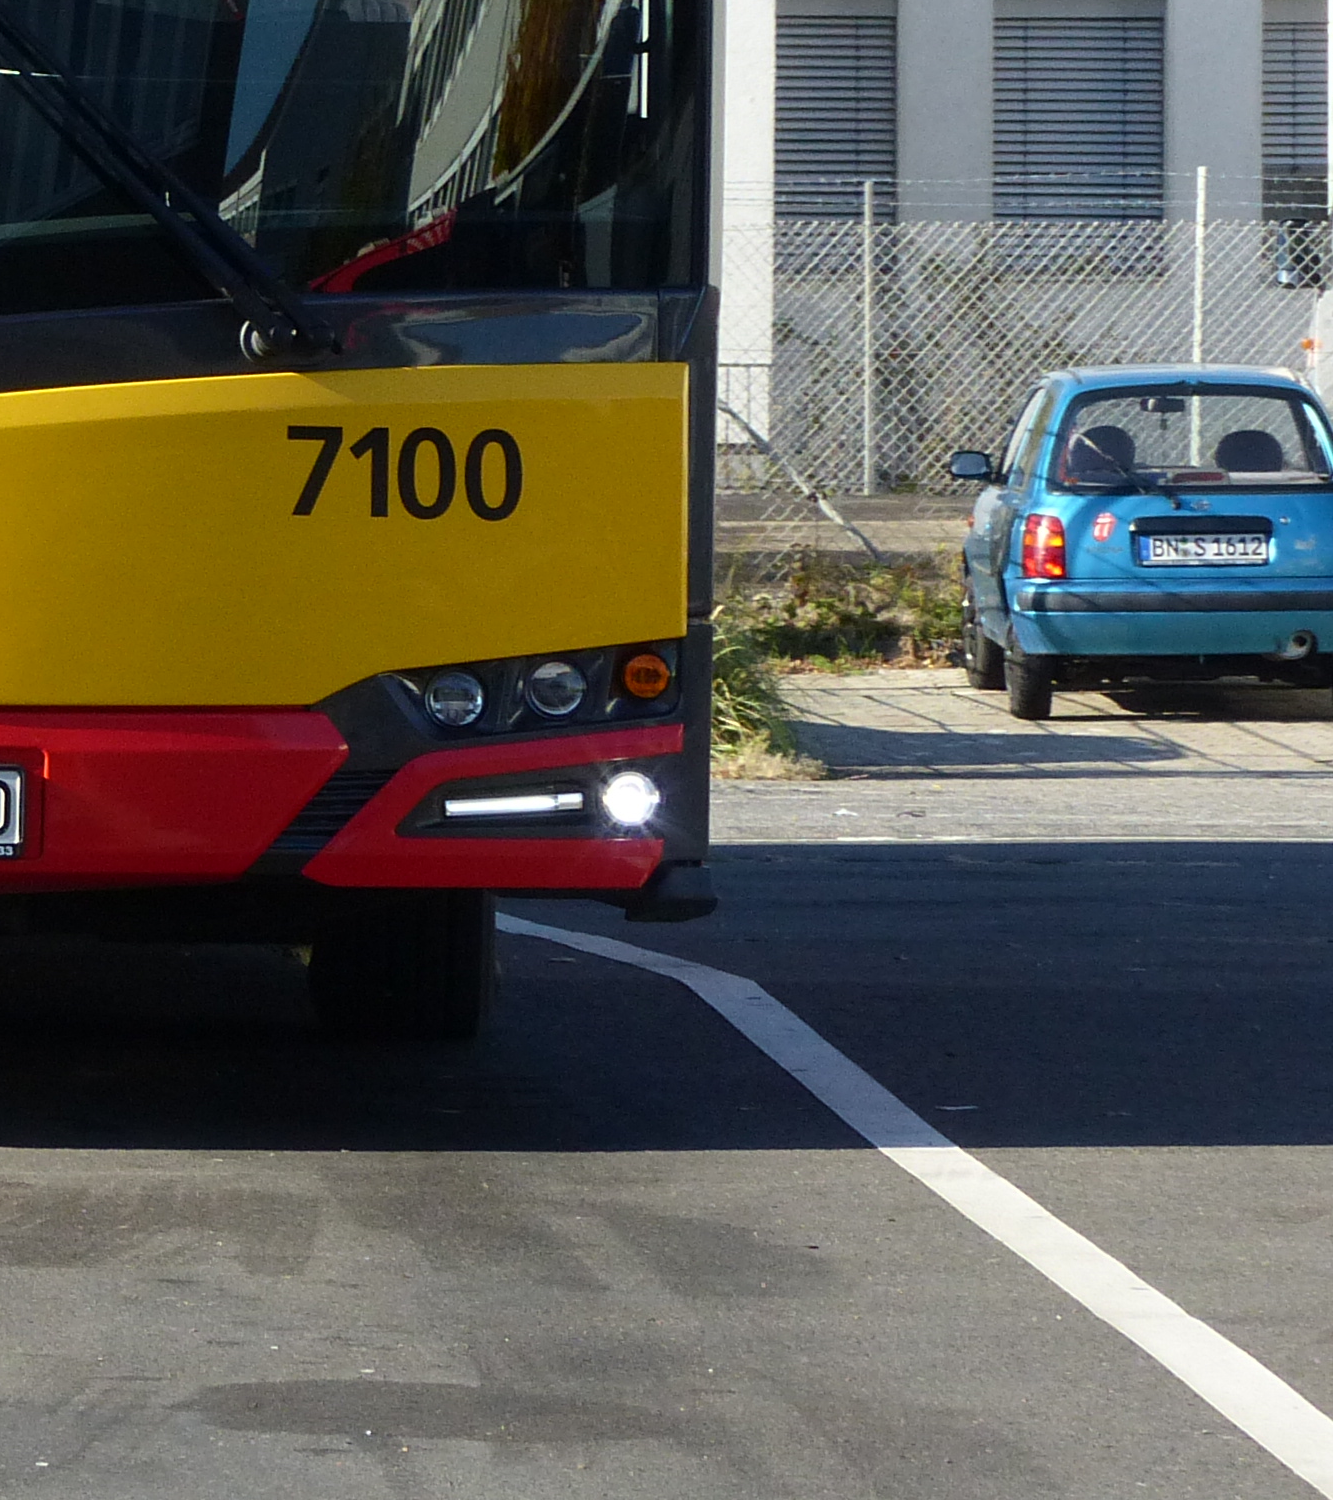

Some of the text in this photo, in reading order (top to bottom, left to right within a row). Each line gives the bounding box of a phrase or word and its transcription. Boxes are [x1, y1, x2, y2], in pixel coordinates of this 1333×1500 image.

[286, 425, 524, 522] 7100
[1152, 536, 1264, 557] BN S 1612
